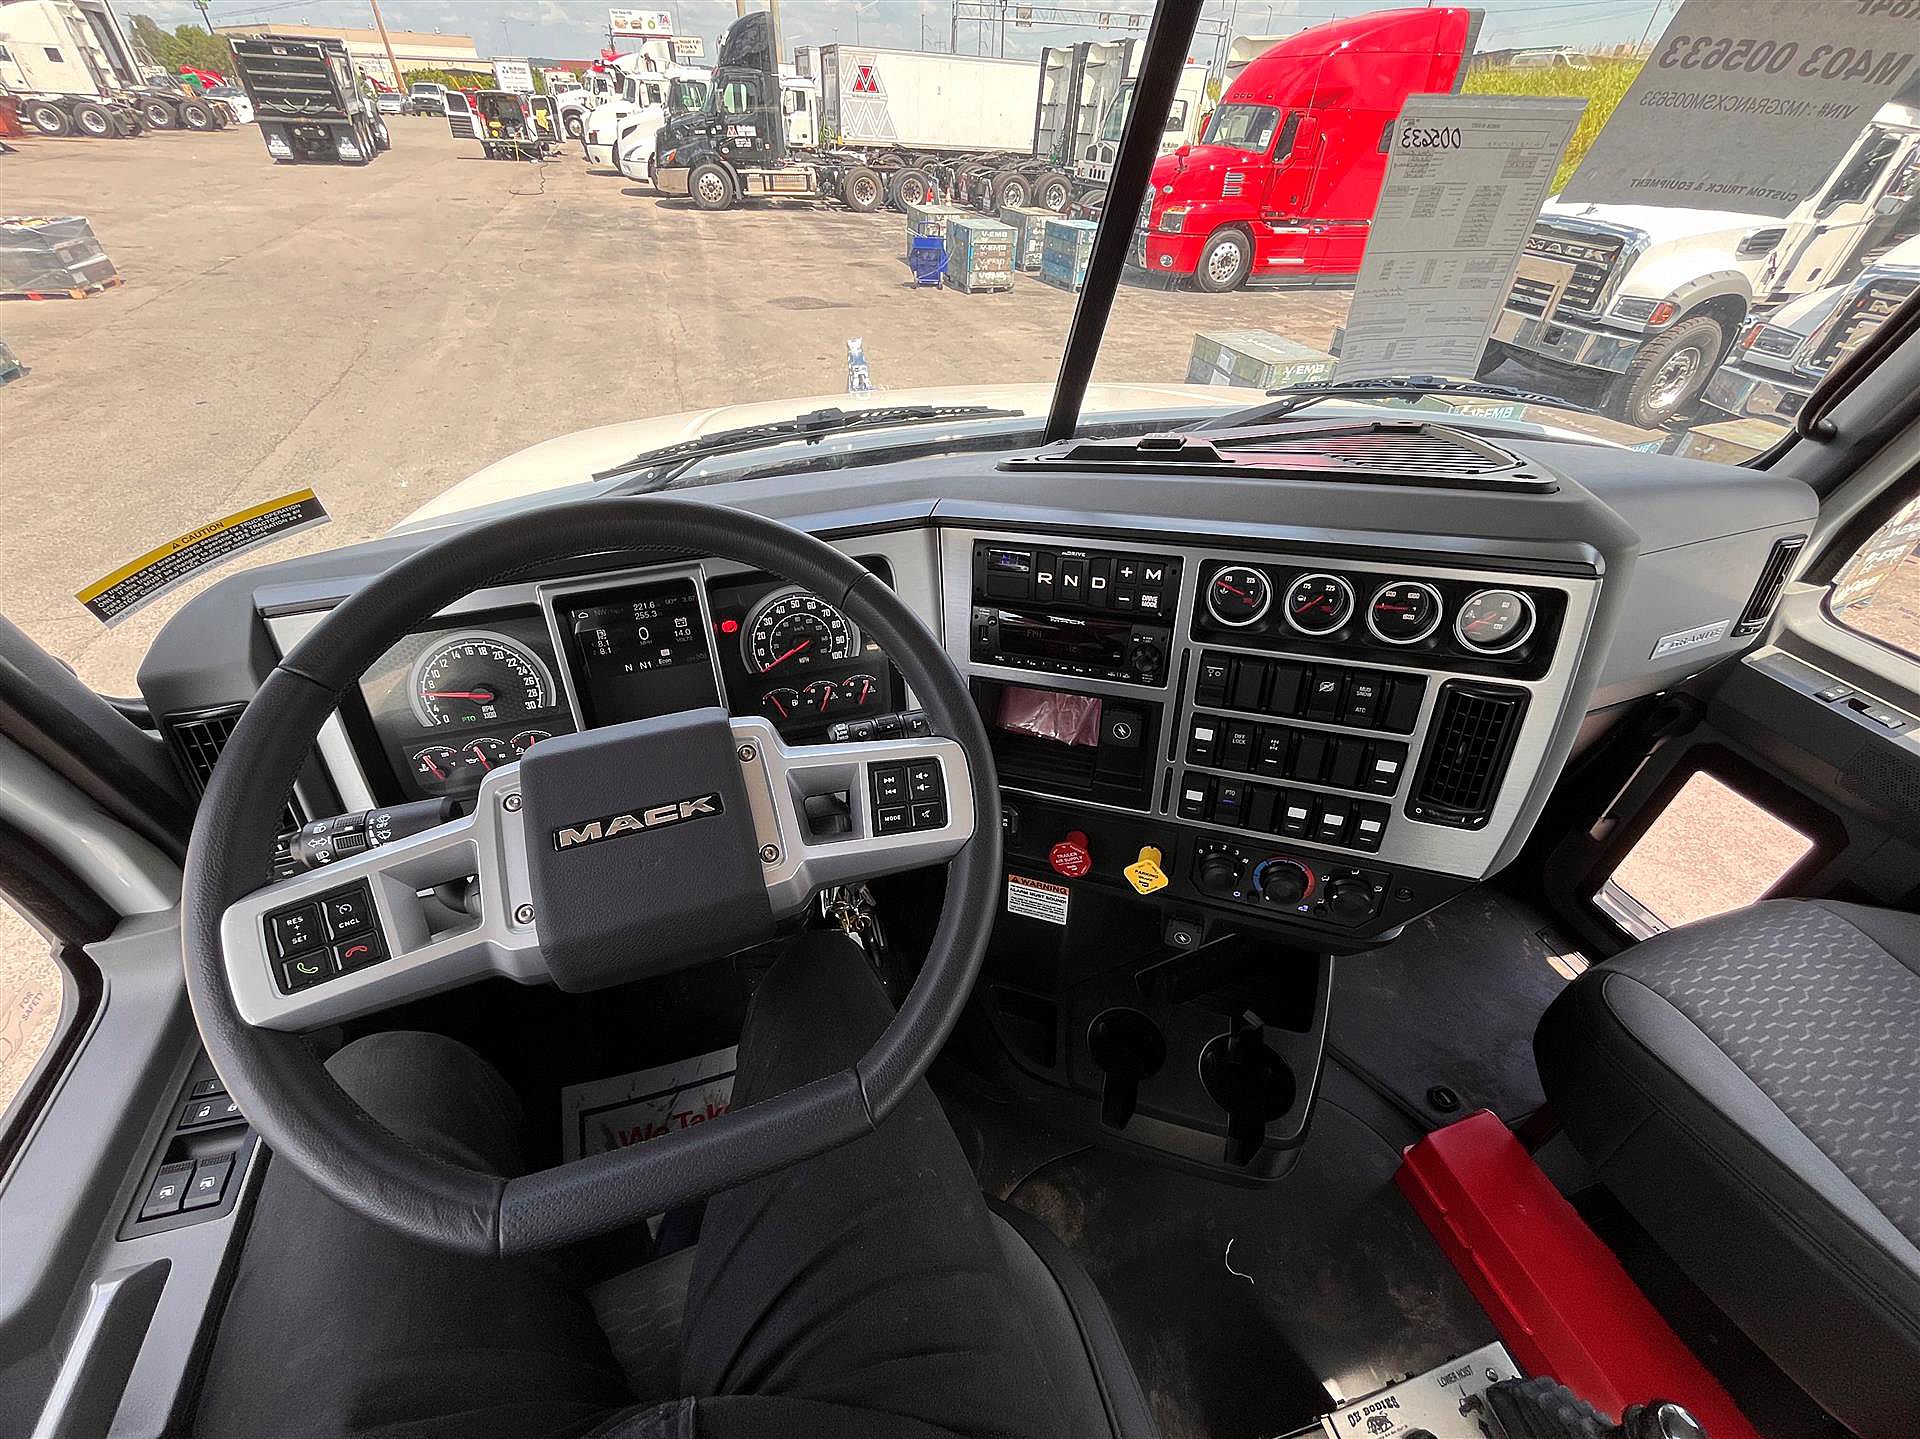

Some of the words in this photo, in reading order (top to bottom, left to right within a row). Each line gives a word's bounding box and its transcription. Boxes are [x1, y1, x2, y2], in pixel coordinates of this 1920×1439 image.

[1526, 238, 1606, 262] MACK
[237, 515, 264, 529] TRUCK
[261, 502, 302, 519] OPERATION
[179, 520, 225, 544] CAUTION
[142, 572, 164, 587] MUST
[249, 517, 289, 535] OPERATION
[178, 559, 201, 573] MACK
[1145, 568, 1162, 581] M
[1037, 572, 1053, 585] R
[1064, 575, 1079, 587] N
[1091, 577, 1106, 589] D
[632, 601, 656, 611] 221.6
[791, 599, 800, 609] 50
[806, 601, 816, 610] 60
[775, 605, 786, 615] 40
[821, 608, 831, 618] 70
[634, 610, 658, 621] 255.3
[763, 616, 773, 626] 30
[831, 619, 841, 629] 80
[638, 626, 649, 641] 0
[674, 628, 692, 637] 14.0
[757, 631, 766, 640] 20
[835, 635, 845, 645] 90
[451, 650, 461, 660] 14
[465, 647, 474, 656] 16
[478, 647, 488, 656] 18
[492, 650, 505, 660] 20
[757, 648, 765, 657] 10
[831, 650, 843, 660] 100
[439, 659, 449, 668] 12
[506, 657, 519, 668] 22
[624, 663, 633, 672] N
[639, 660, 652, 670] N1
[431, 669, 441, 680] 10
[516, 666, 528, 676] 24
[428, 680, 435, 689] 8
[523, 677, 536, 686] 26
[526, 688, 539, 698] 28
[481, 705, 495, 713] RPM
[524, 700, 537, 710] 30
[1354, 706, 1367, 714] ATC
[443, 714, 450, 723] 0
[461, 715, 476, 723] PTO
[1224, 788, 1236, 797] PTO
[559, 796, 718, 847] MACK
[884, 814, 901, 822] MODE
[375, 821, 389, 829] OFF
[1020, 877, 1069, 896] WARNING
[286, 915, 304, 926] RES
[338, 917, 361, 929] CNCL
[291, 933, 308, 946] SET
[1362, 1395, 1401, 1417] BODIES
